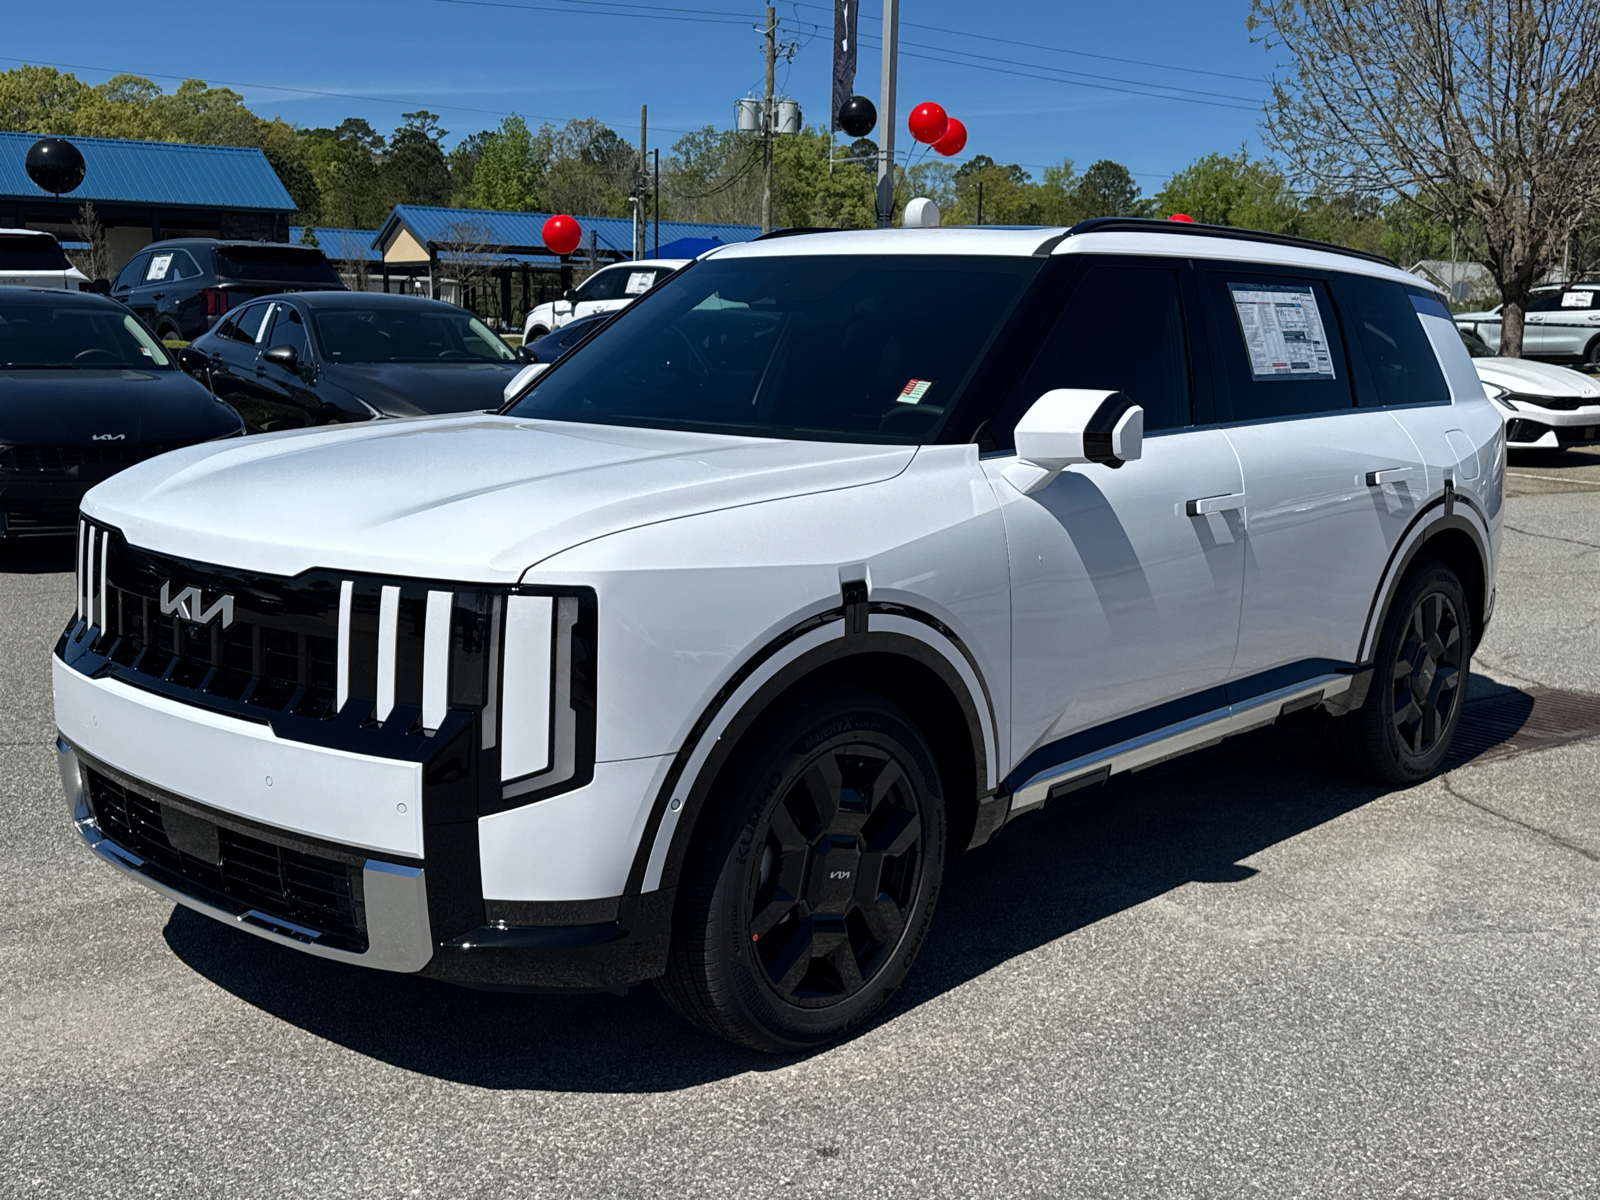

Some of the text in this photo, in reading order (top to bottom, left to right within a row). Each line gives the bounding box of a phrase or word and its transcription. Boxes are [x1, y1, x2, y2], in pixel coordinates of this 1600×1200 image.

[92, 433, 126, 441] KIA
[160, 580, 234, 630] KIA
[855, 720, 881, 730] SOLUS
[735, 770, 783, 865] KUMHO
[829, 871, 851, 880] KIA
[731, 903, 741, 953] OUTSIDE
[903, 885, 938, 970] KUMHO
